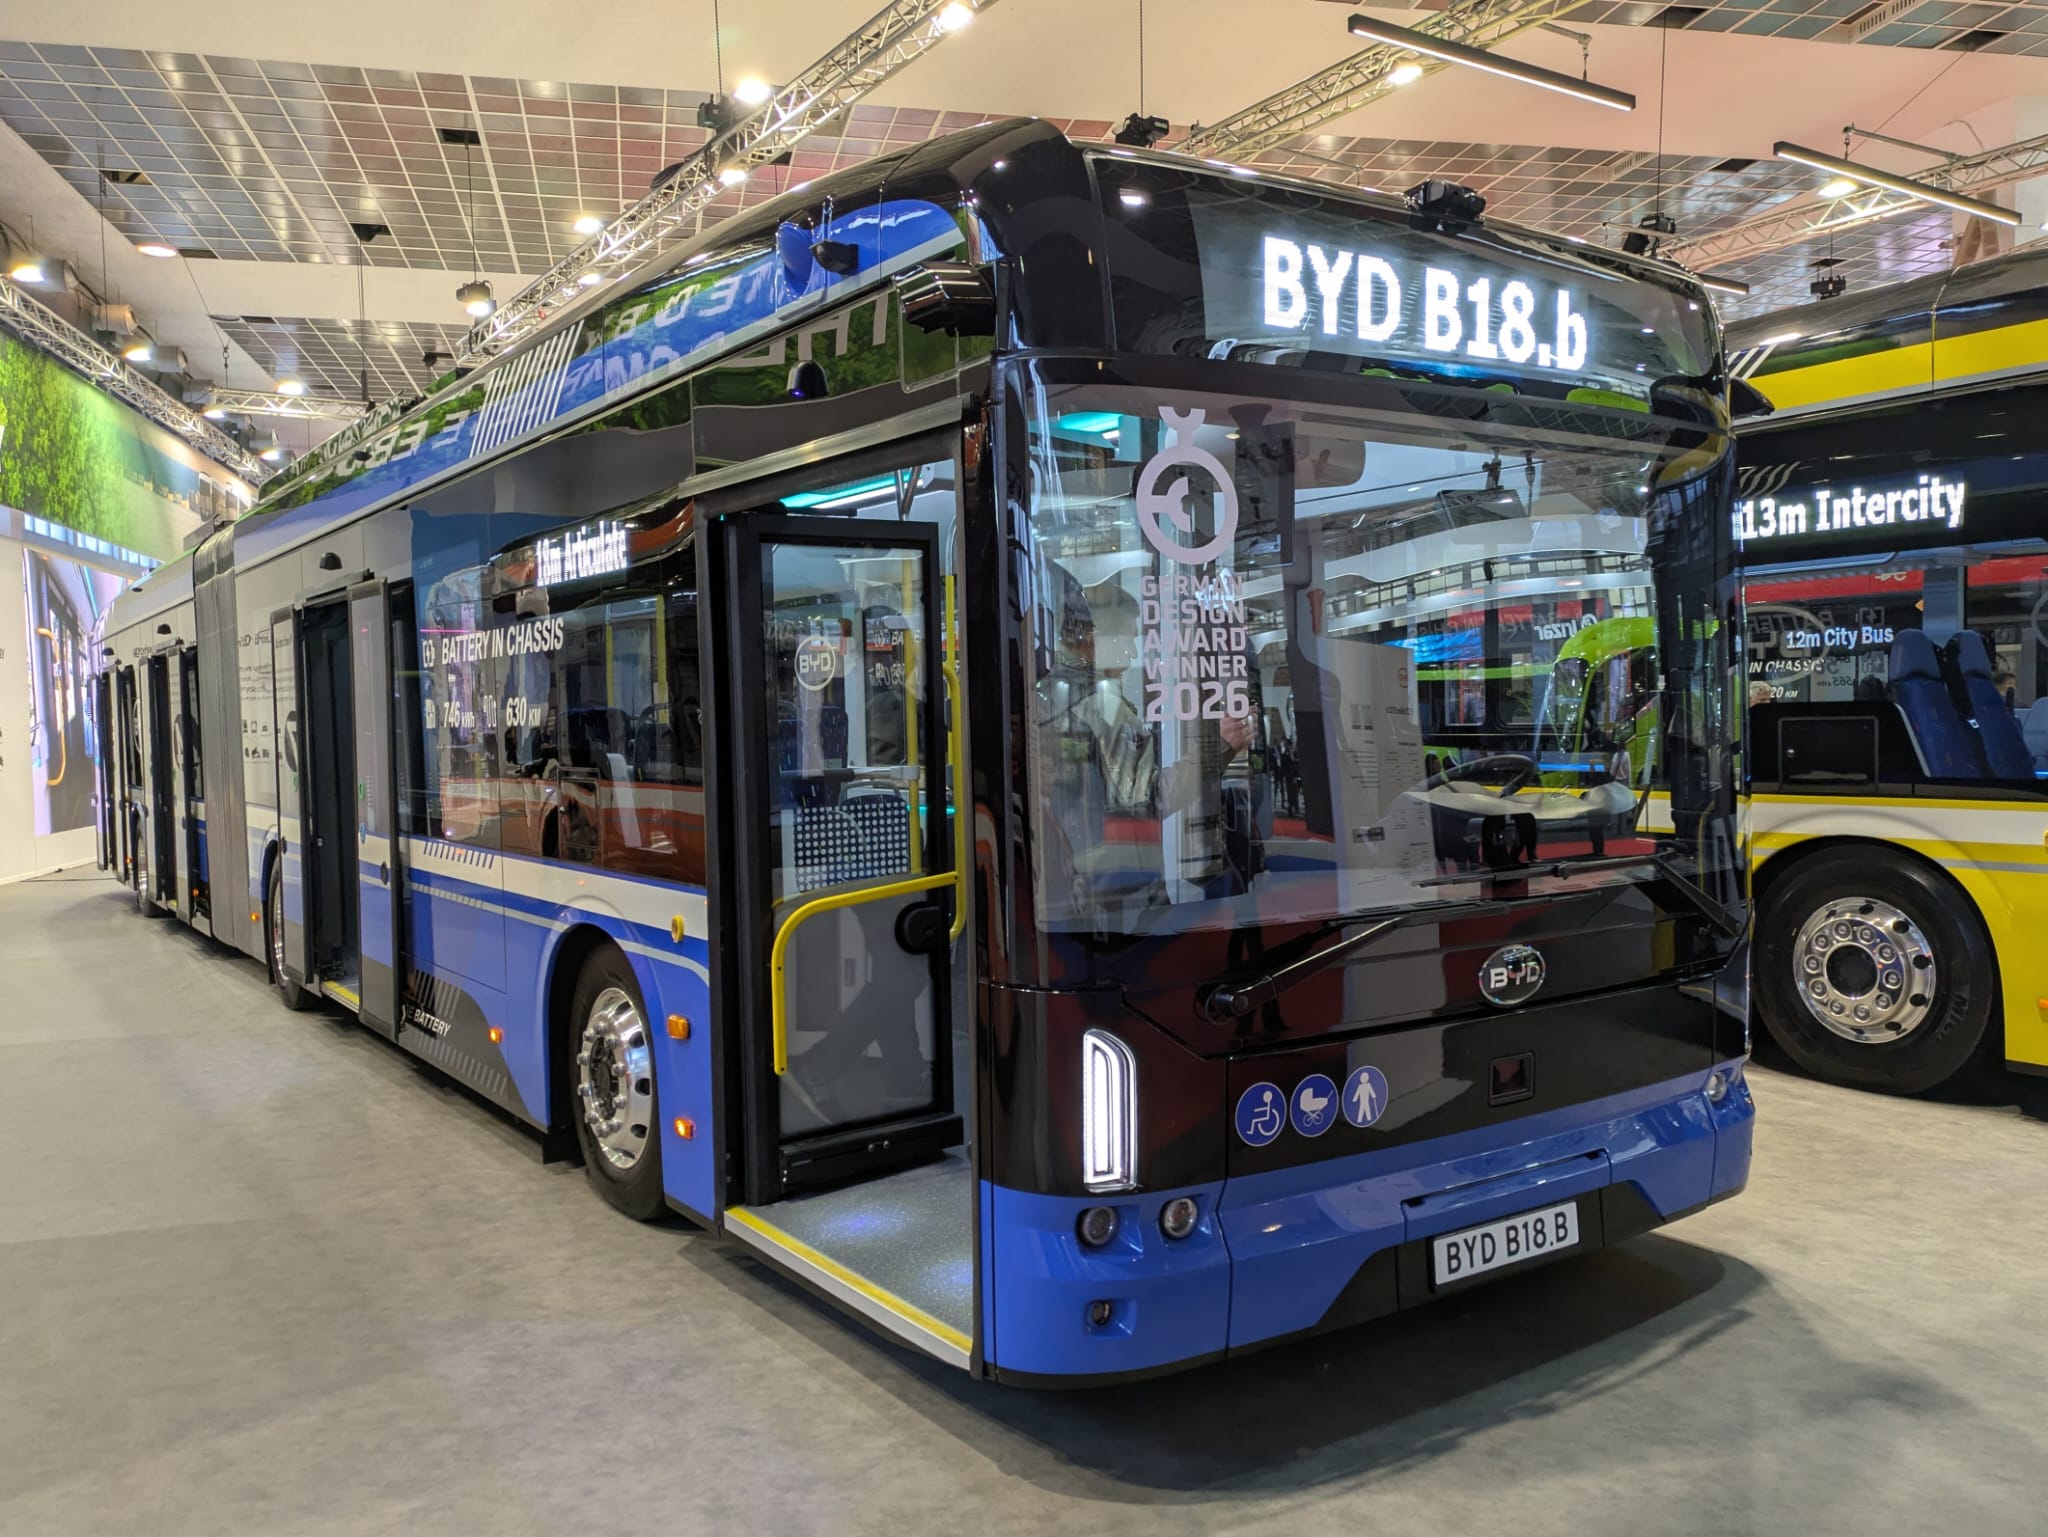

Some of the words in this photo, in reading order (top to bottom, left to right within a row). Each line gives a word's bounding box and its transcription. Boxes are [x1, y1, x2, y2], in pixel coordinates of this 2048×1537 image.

[1264, 236, 1401, 342] BYD
[1425, 267, 1588, 371] B18.b
[1742, 498, 1808, 540] 13m
[1816, 475, 1964, 529] Intercity
[565, 520, 628, 580] Articulate
[1142, 575, 1243, 597] GERMAN
[1143, 600, 1245, 625] DESIGN
[442, 631, 490, 665] BATTERY
[491, 627, 504, 658] IN
[506, 617, 564, 656] CHASSIS
[1144, 628, 1247, 652] AWARD
[1786, 630, 1820, 649] 12m
[1824, 627, 1858, 650] City
[1861, 625, 1894, 645] Bus
[799, 652, 832, 674] BYD
[1145, 655, 1248, 680] WINNER
[1749, 661, 1763, 674] IN
[443, 701, 461, 728] 746
[506, 697, 527, 727] 630
[1145, 681, 1250, 721] 2026
[1490, 963, 1541, 989] BYD
[413, 1008, 452, 1037] BATTERY
[1446, 1230, 1496, 1275] BYD
[1506, 1211, 1569, 1257] B18.B
